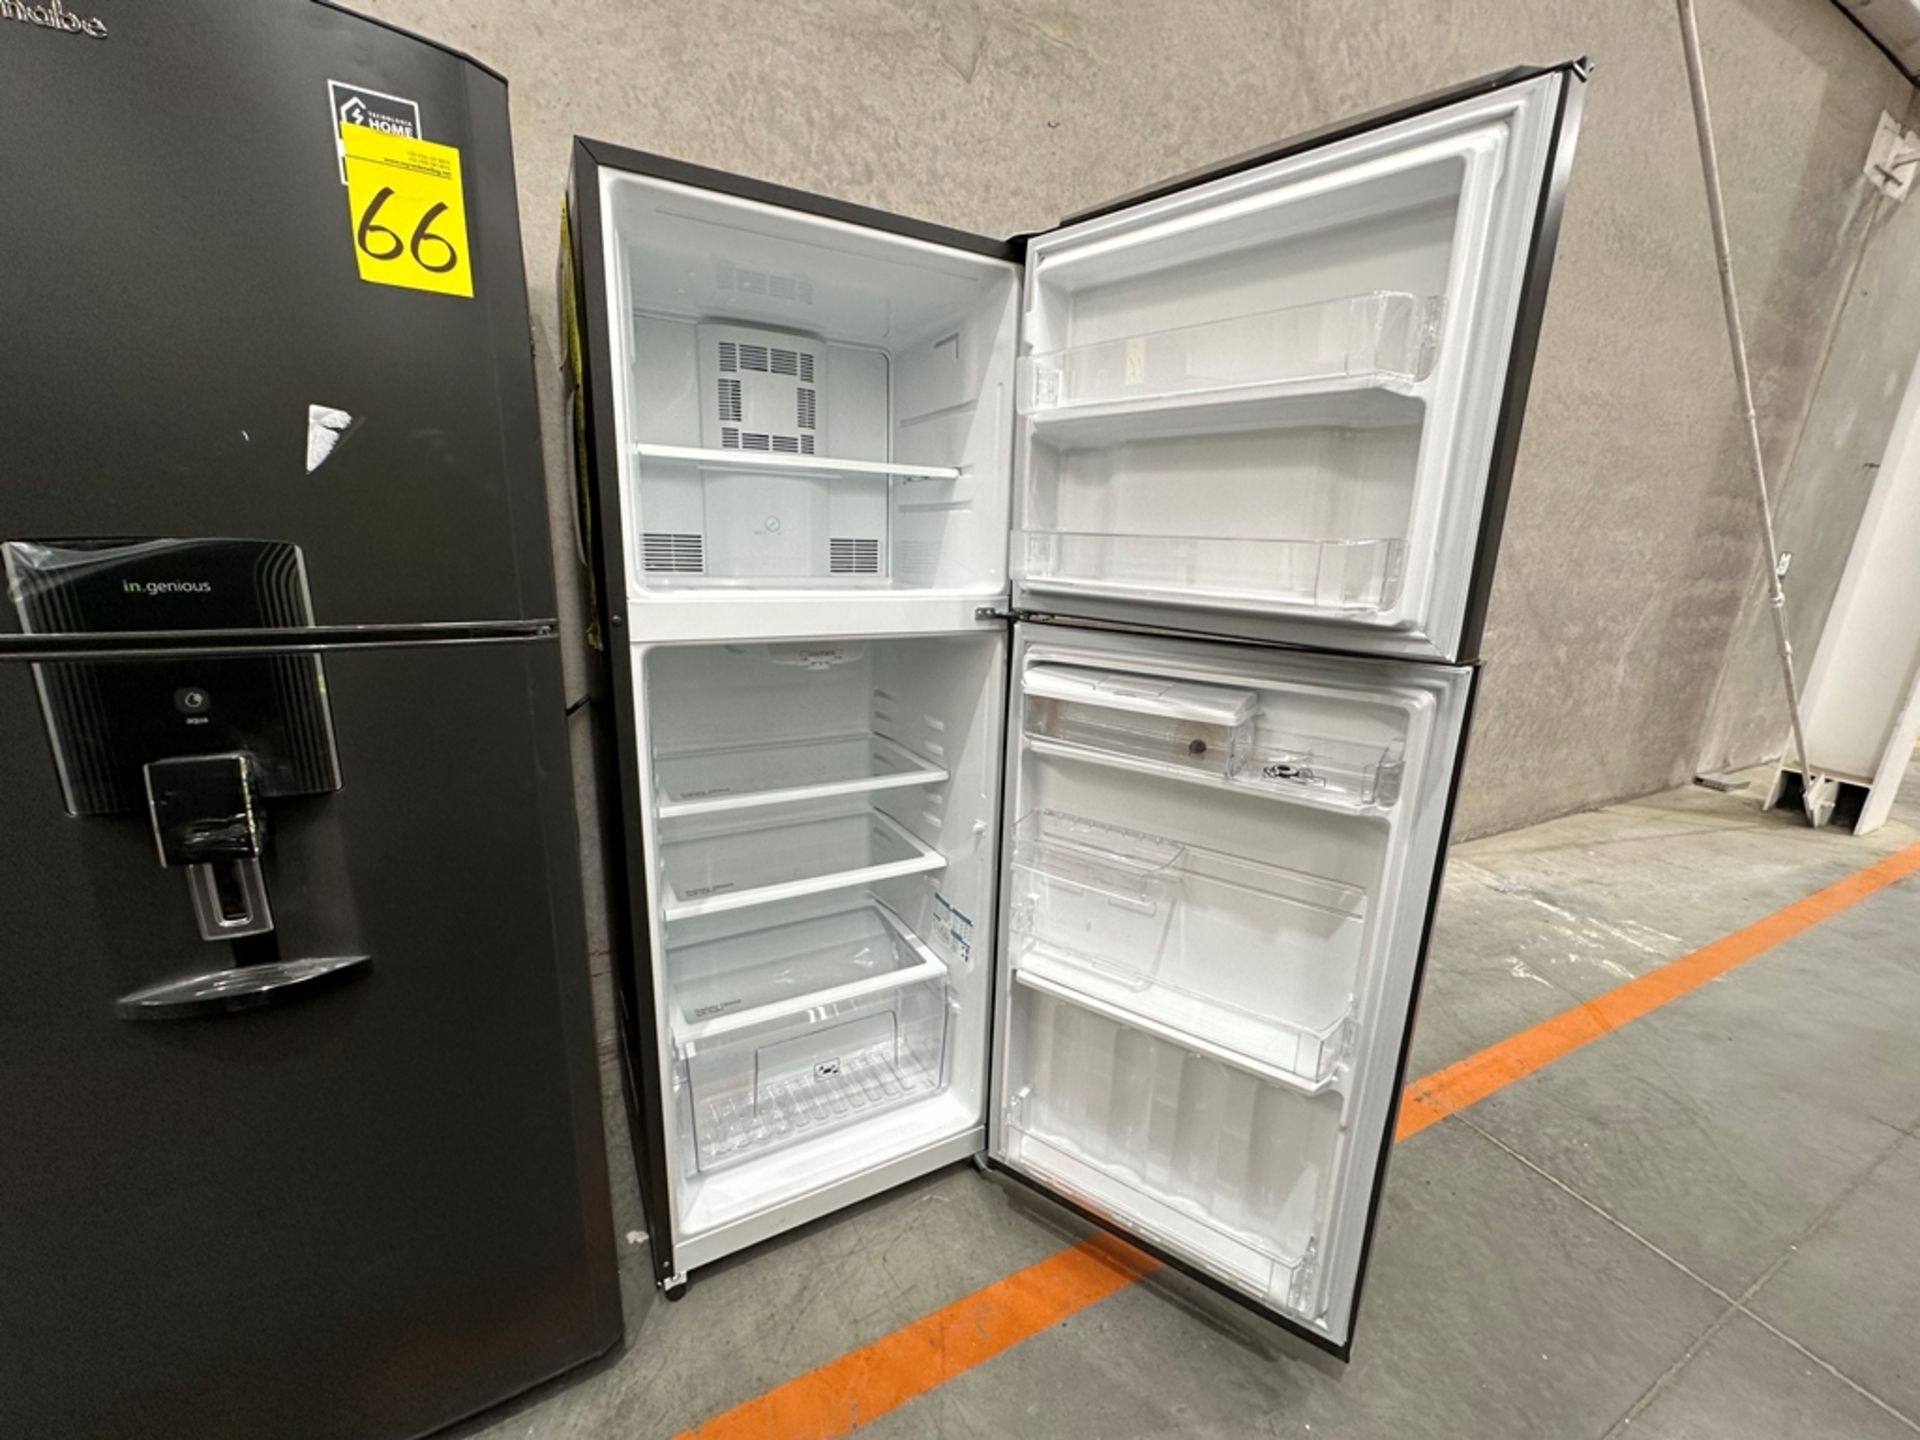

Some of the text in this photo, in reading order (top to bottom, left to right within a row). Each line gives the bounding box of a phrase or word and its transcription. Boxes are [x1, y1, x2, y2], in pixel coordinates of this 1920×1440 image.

[368, 118, 413, 137] HOME
[357, 187, 457, 273] 66
[122, 580, 212, 595] in.genious
